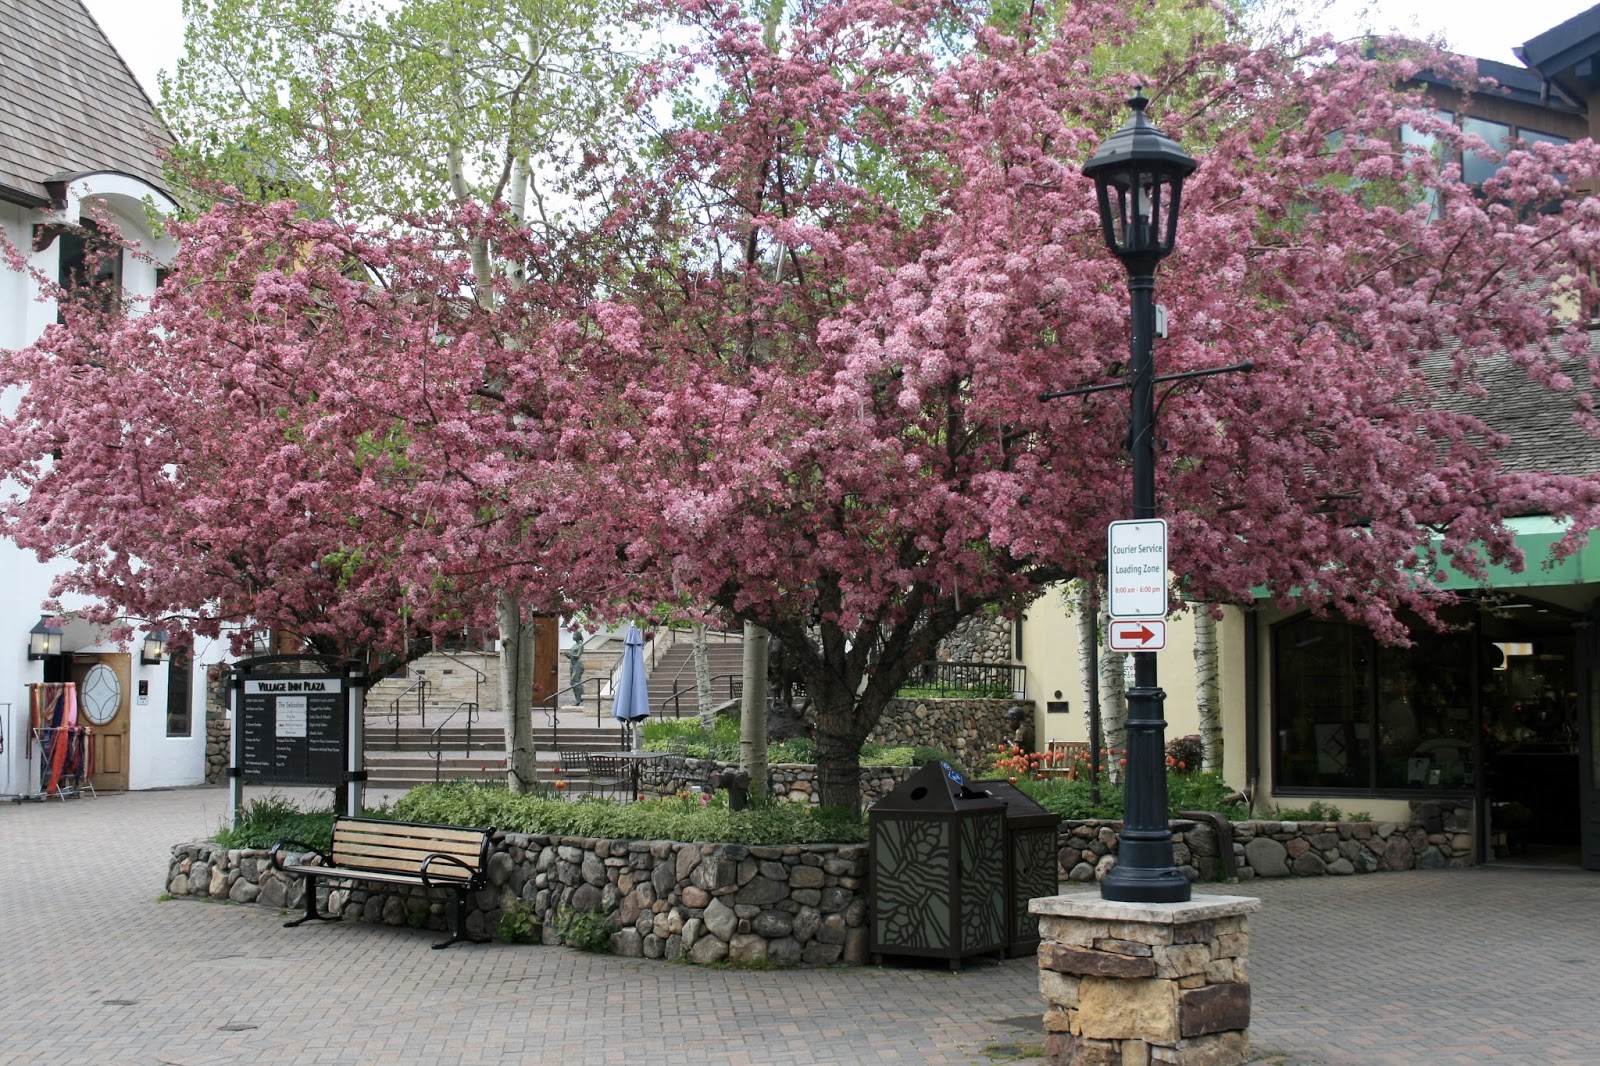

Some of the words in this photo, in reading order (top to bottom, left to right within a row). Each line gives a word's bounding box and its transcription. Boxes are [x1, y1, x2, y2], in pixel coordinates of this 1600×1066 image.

[1113, 545, 1137, 555] Courier
[1138, 544, 1163, 554] Service
[1115, 565, 1142, 575] Loading
[1143, 564, 1160, 573] Zone
[258, 682, 286, 691] VILLAGE
[288, 682, 301, 691] INN
[304, 682, 325, 691] PLAZA
